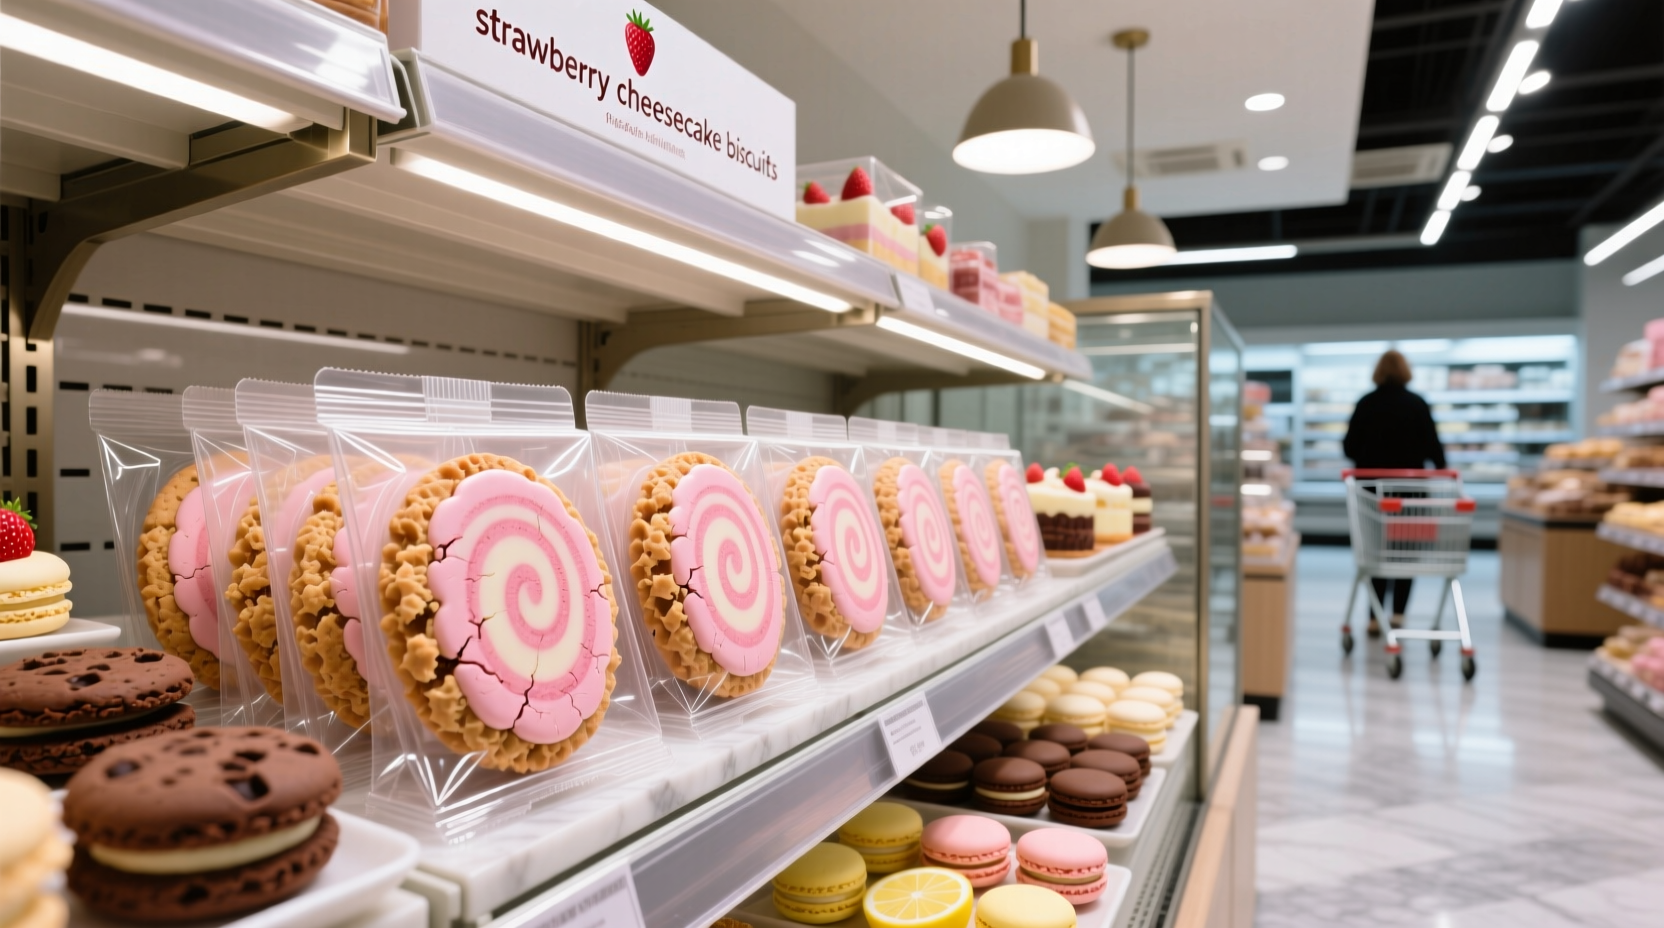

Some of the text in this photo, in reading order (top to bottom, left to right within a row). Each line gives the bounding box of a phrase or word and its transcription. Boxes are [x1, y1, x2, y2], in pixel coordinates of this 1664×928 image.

[475, 8, 610, 101] strawberry
[617, 78, 722, 152] cheesecake
[727, 131, 778, 181] biscuits
